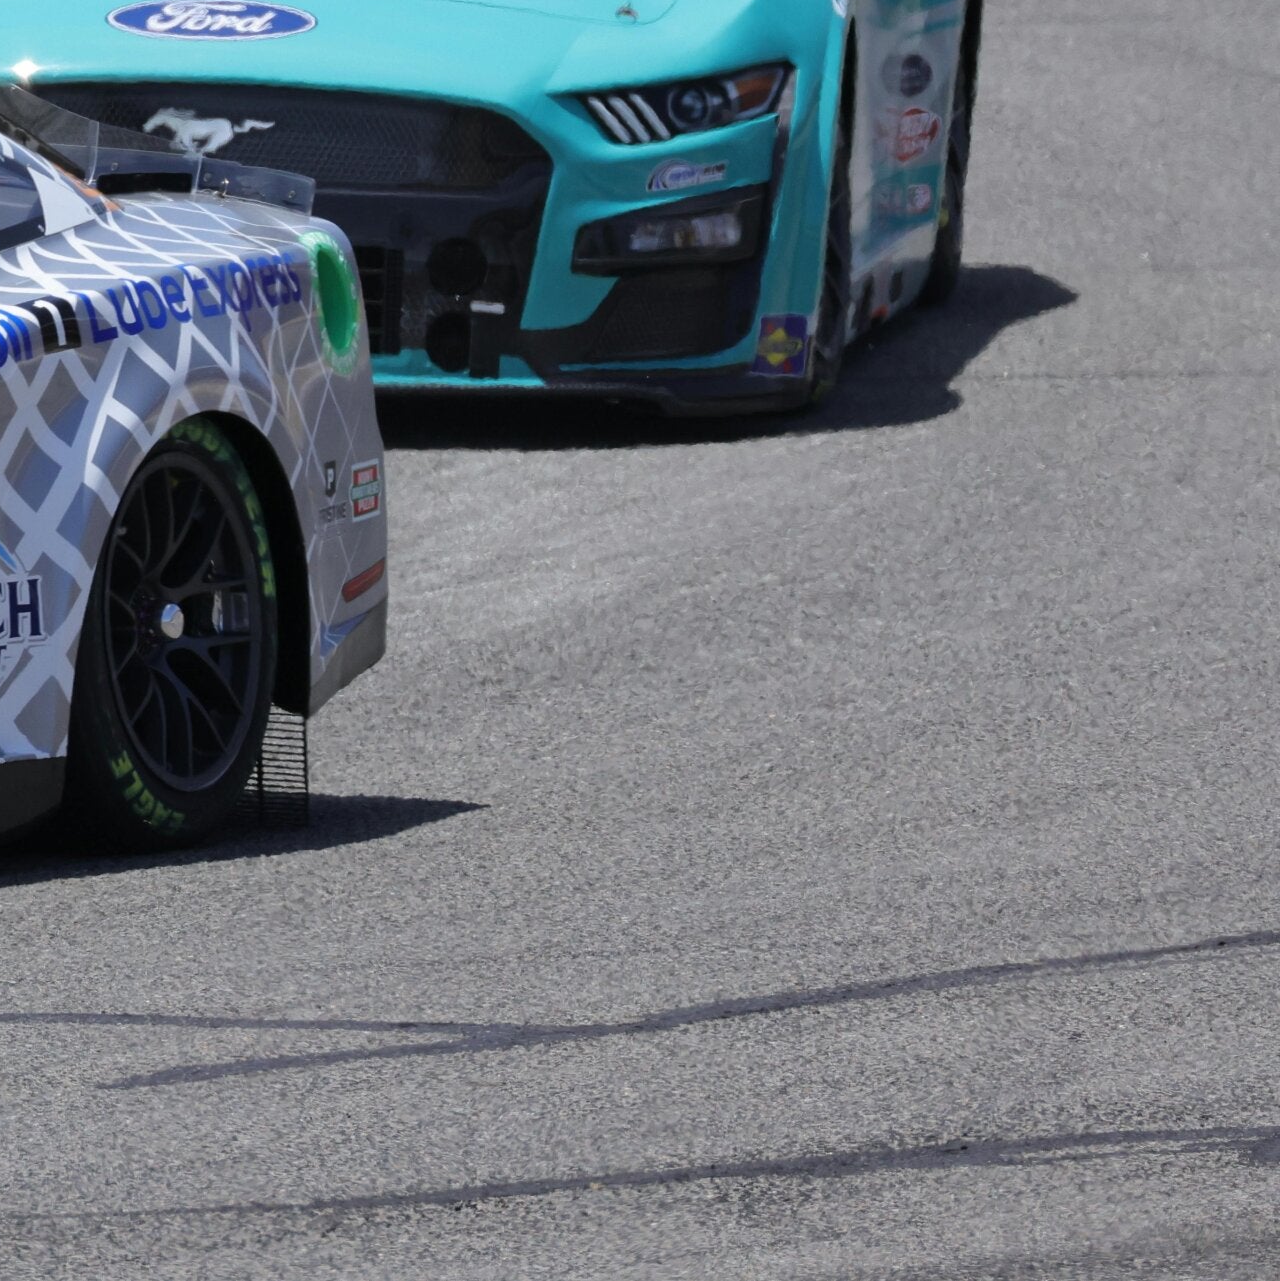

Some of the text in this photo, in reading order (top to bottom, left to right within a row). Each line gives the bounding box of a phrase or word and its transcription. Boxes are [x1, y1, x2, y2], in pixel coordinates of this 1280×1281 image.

[145, 0, 272, 36] Ford
[73, 266, 192, 344] Lube
[181, 252, 302, 332] Express
